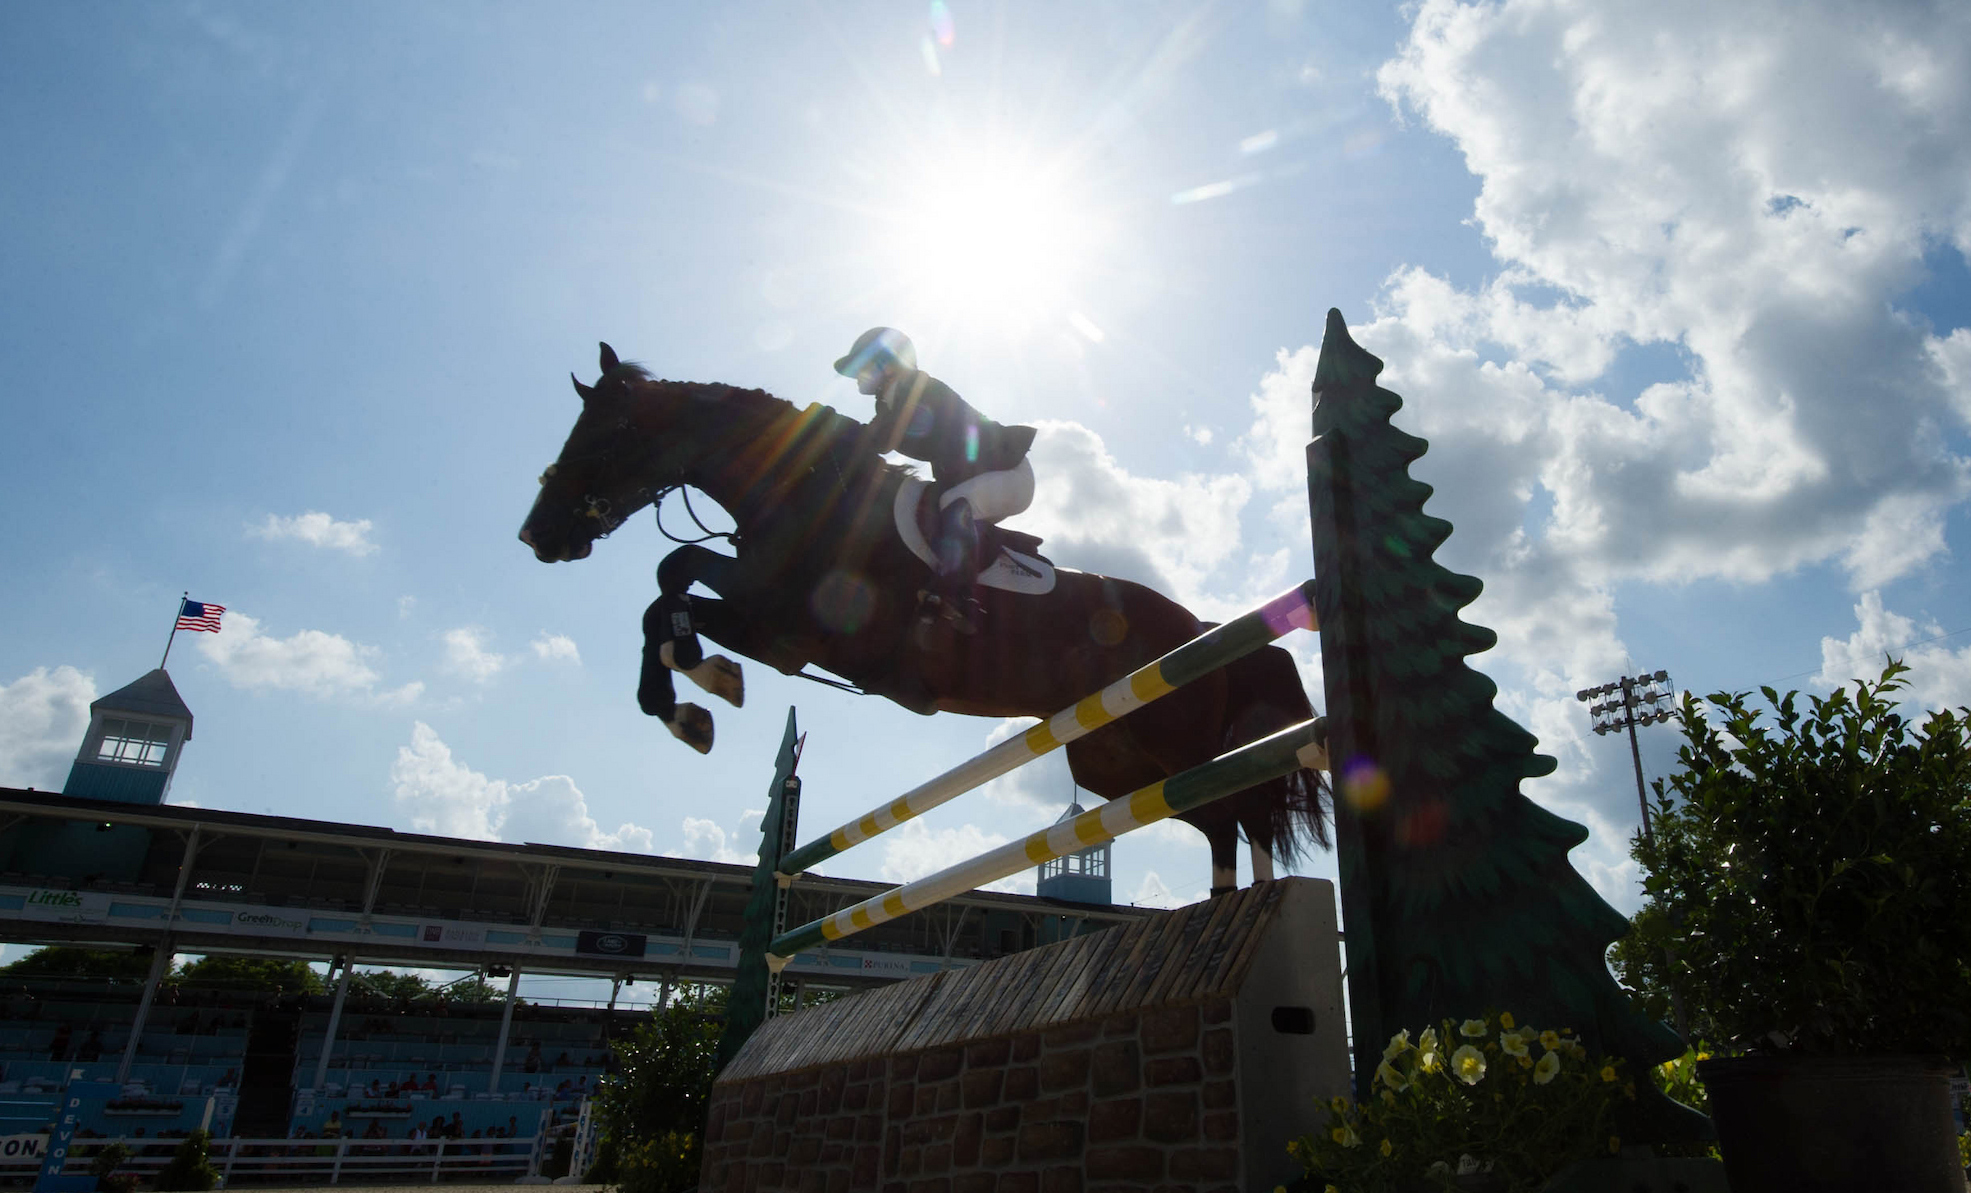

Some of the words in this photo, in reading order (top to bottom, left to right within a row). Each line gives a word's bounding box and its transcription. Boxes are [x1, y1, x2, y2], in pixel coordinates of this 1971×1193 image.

[237, 911, 303, 933] GreenDrop
[48, 1097, 81, 1176] DEVON
[0, 1139, 39, 1157] ON
